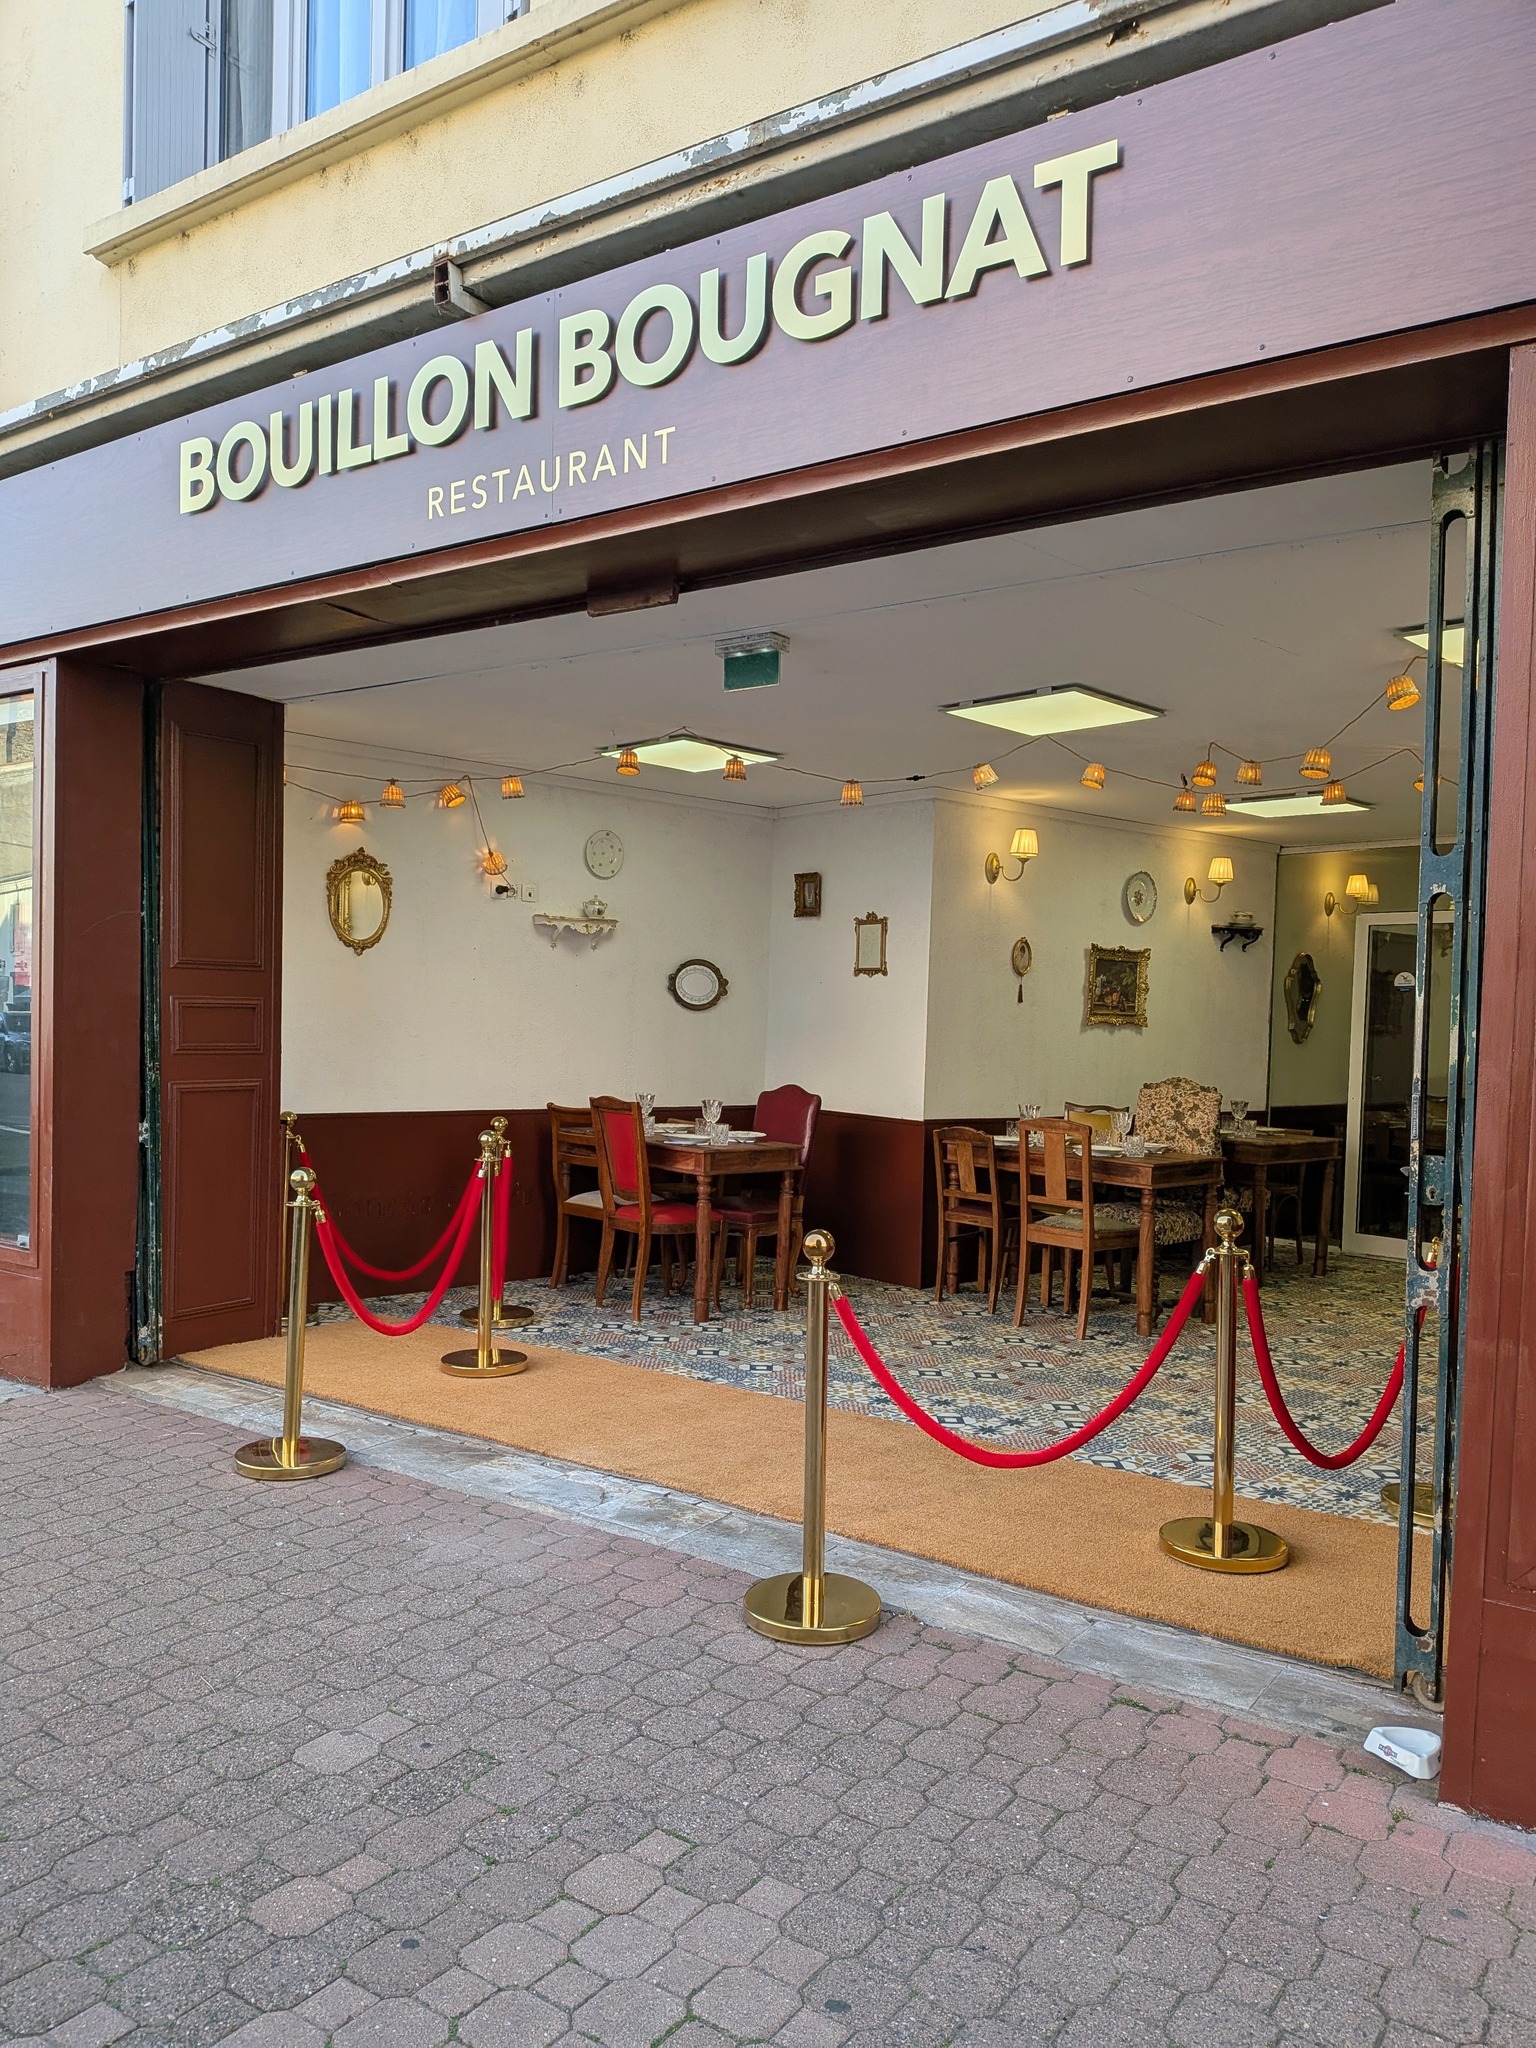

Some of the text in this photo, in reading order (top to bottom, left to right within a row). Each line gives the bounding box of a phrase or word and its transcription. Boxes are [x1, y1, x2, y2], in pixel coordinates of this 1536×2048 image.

[180, 139, 1119, 515] BOUILLON BOUGNAT
[427, 426, 676, 520] RESTAURANT
